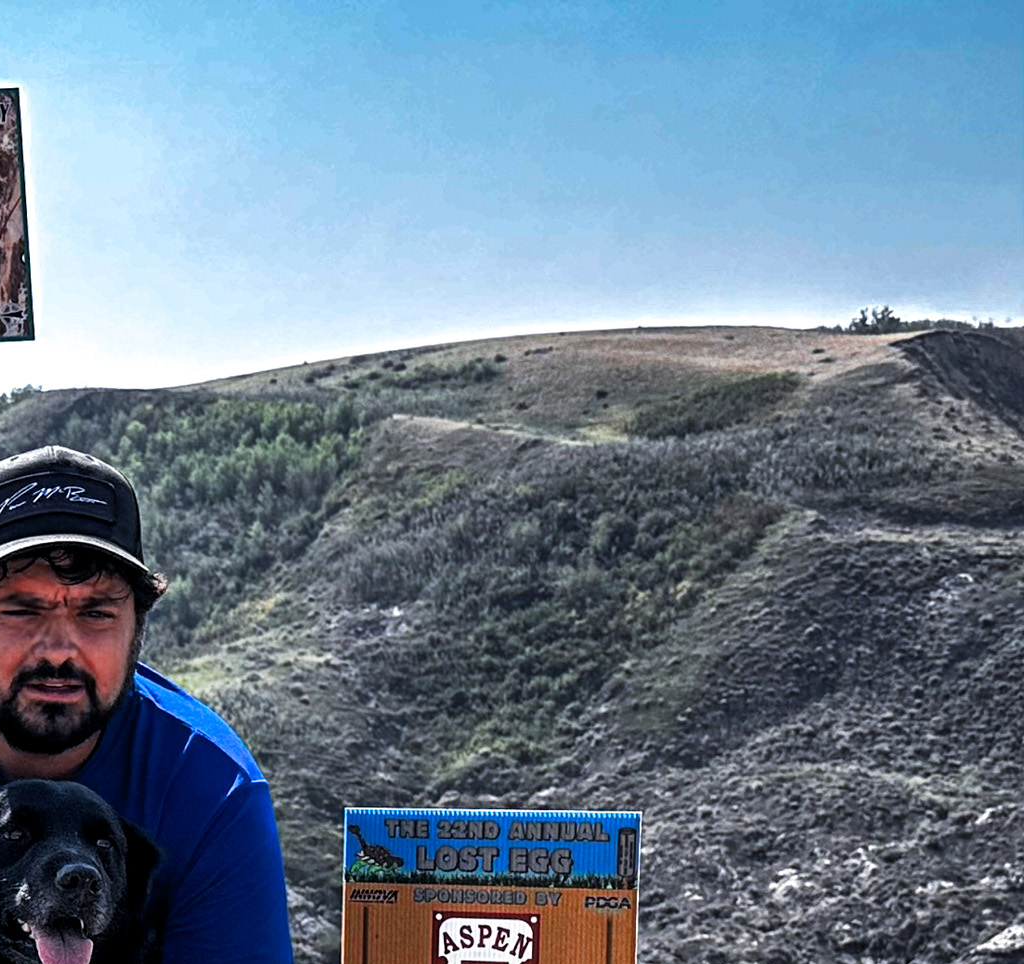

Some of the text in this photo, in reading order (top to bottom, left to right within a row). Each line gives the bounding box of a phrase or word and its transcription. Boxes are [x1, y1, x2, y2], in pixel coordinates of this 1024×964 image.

[385, 818, 610, 843] THE 22ND ANNUAL
[416, 845, 574, 875] LOST EGG
[349, 888, 398, 904] INNOVA
[413, 888, 562, 907] SPONSORED BY
[584, 896, 631, 909] PDGA
[442, 925, 533, 959] ASPEN
